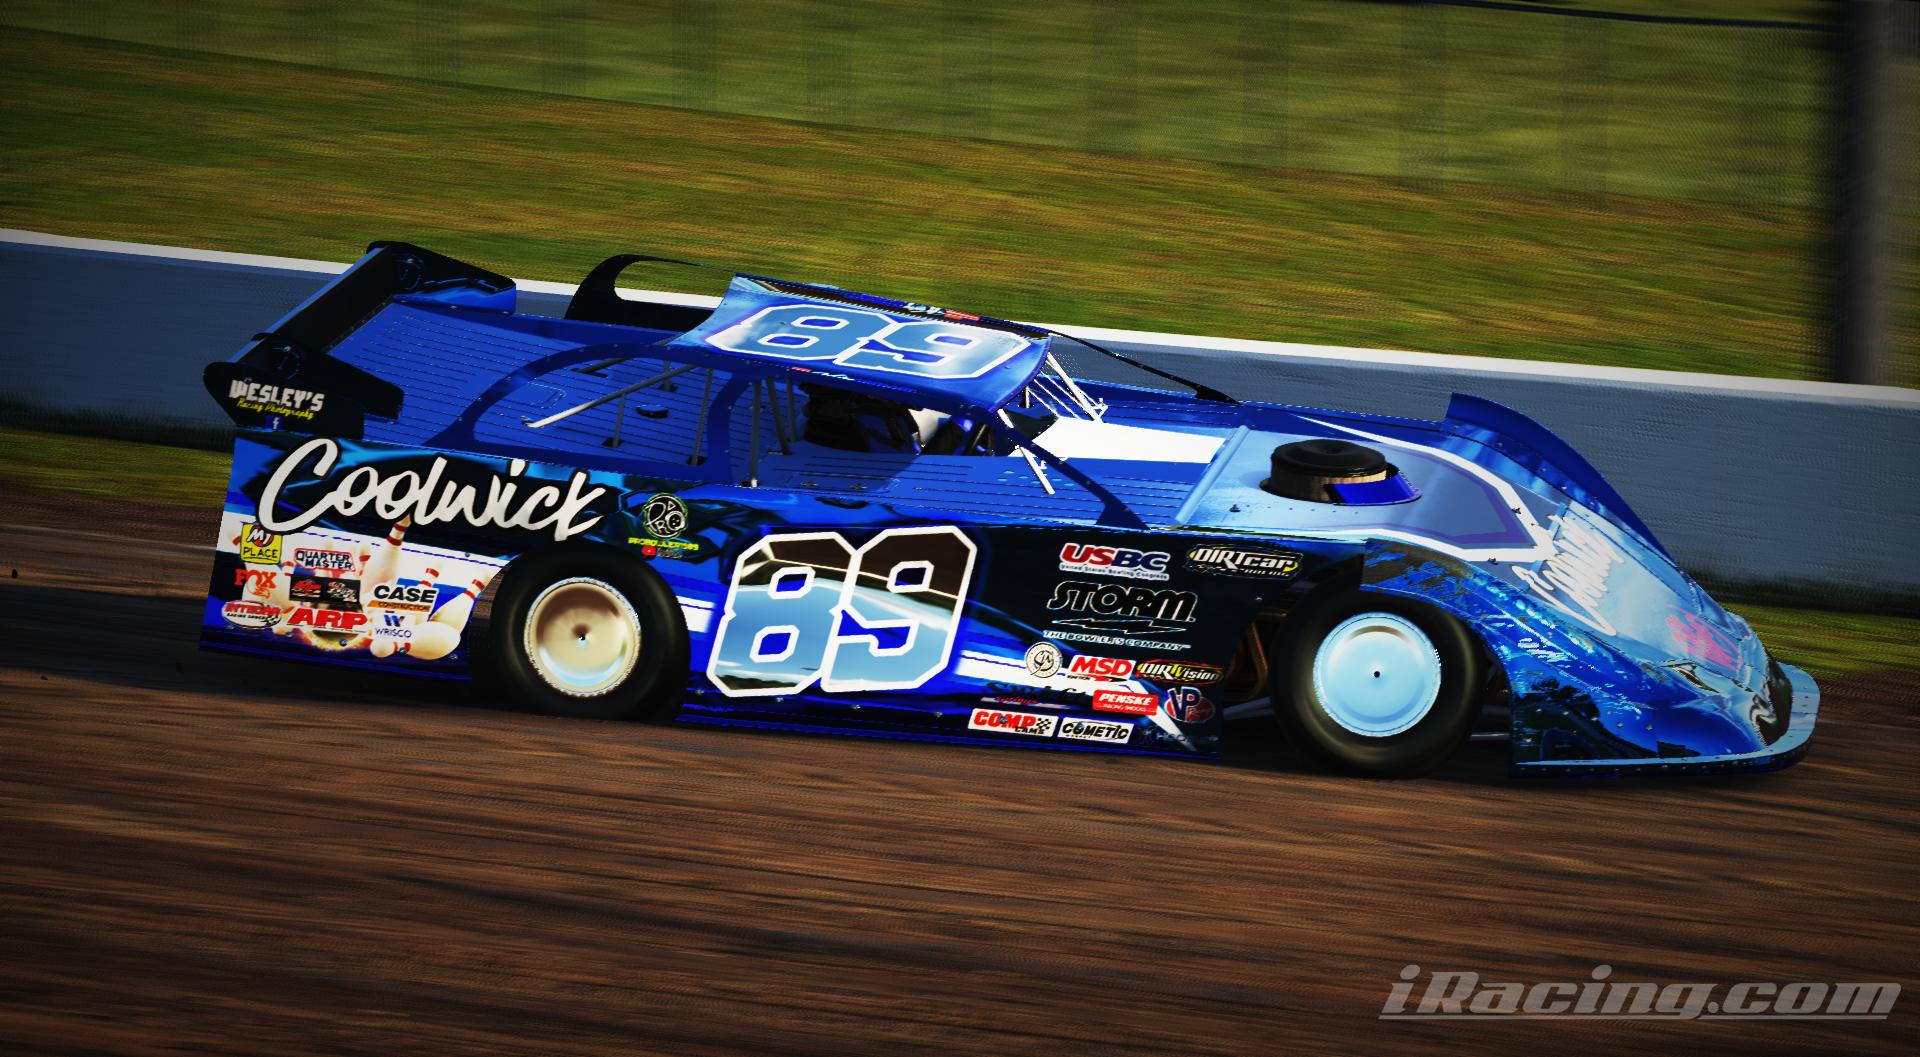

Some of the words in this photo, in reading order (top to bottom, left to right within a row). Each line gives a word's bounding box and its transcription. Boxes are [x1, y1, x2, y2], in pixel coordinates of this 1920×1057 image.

[705, 303, 1033, 379] 89
[229, 380, 325, 412] WESLEY'S
[258, 437, 606, 542] Coolwick
[243, 546, 278, 559] PLACE
[296, 550, 351, 562] QUARTER
[1060, 543, 1170, 573] USBC
[1193, 548, 1299, 571] DIRTcar
[305, 559, 353, 570] MASTER
[234, 569, 277, 589] FOX
[374, 585, 437, 603] CASE
[287, 607, 368, 629] ARP
[706, 525, 978, 697] 89
[375, 627, 412, 638] WRISCO
[1043, 630, 1066, 640] THE
[1125, 638, 1184, 651] COMPANY
[1071, 657, 1132, 676] MSD
[1098, 693, 1153, 706] PENSKE
[1167, 686, 1202, 722] VP
[973, 711, 1037, 729] COMP
[1015, 726, 1045, 735] CAMS
[1062, 721, 1130, 740] COMETIC
